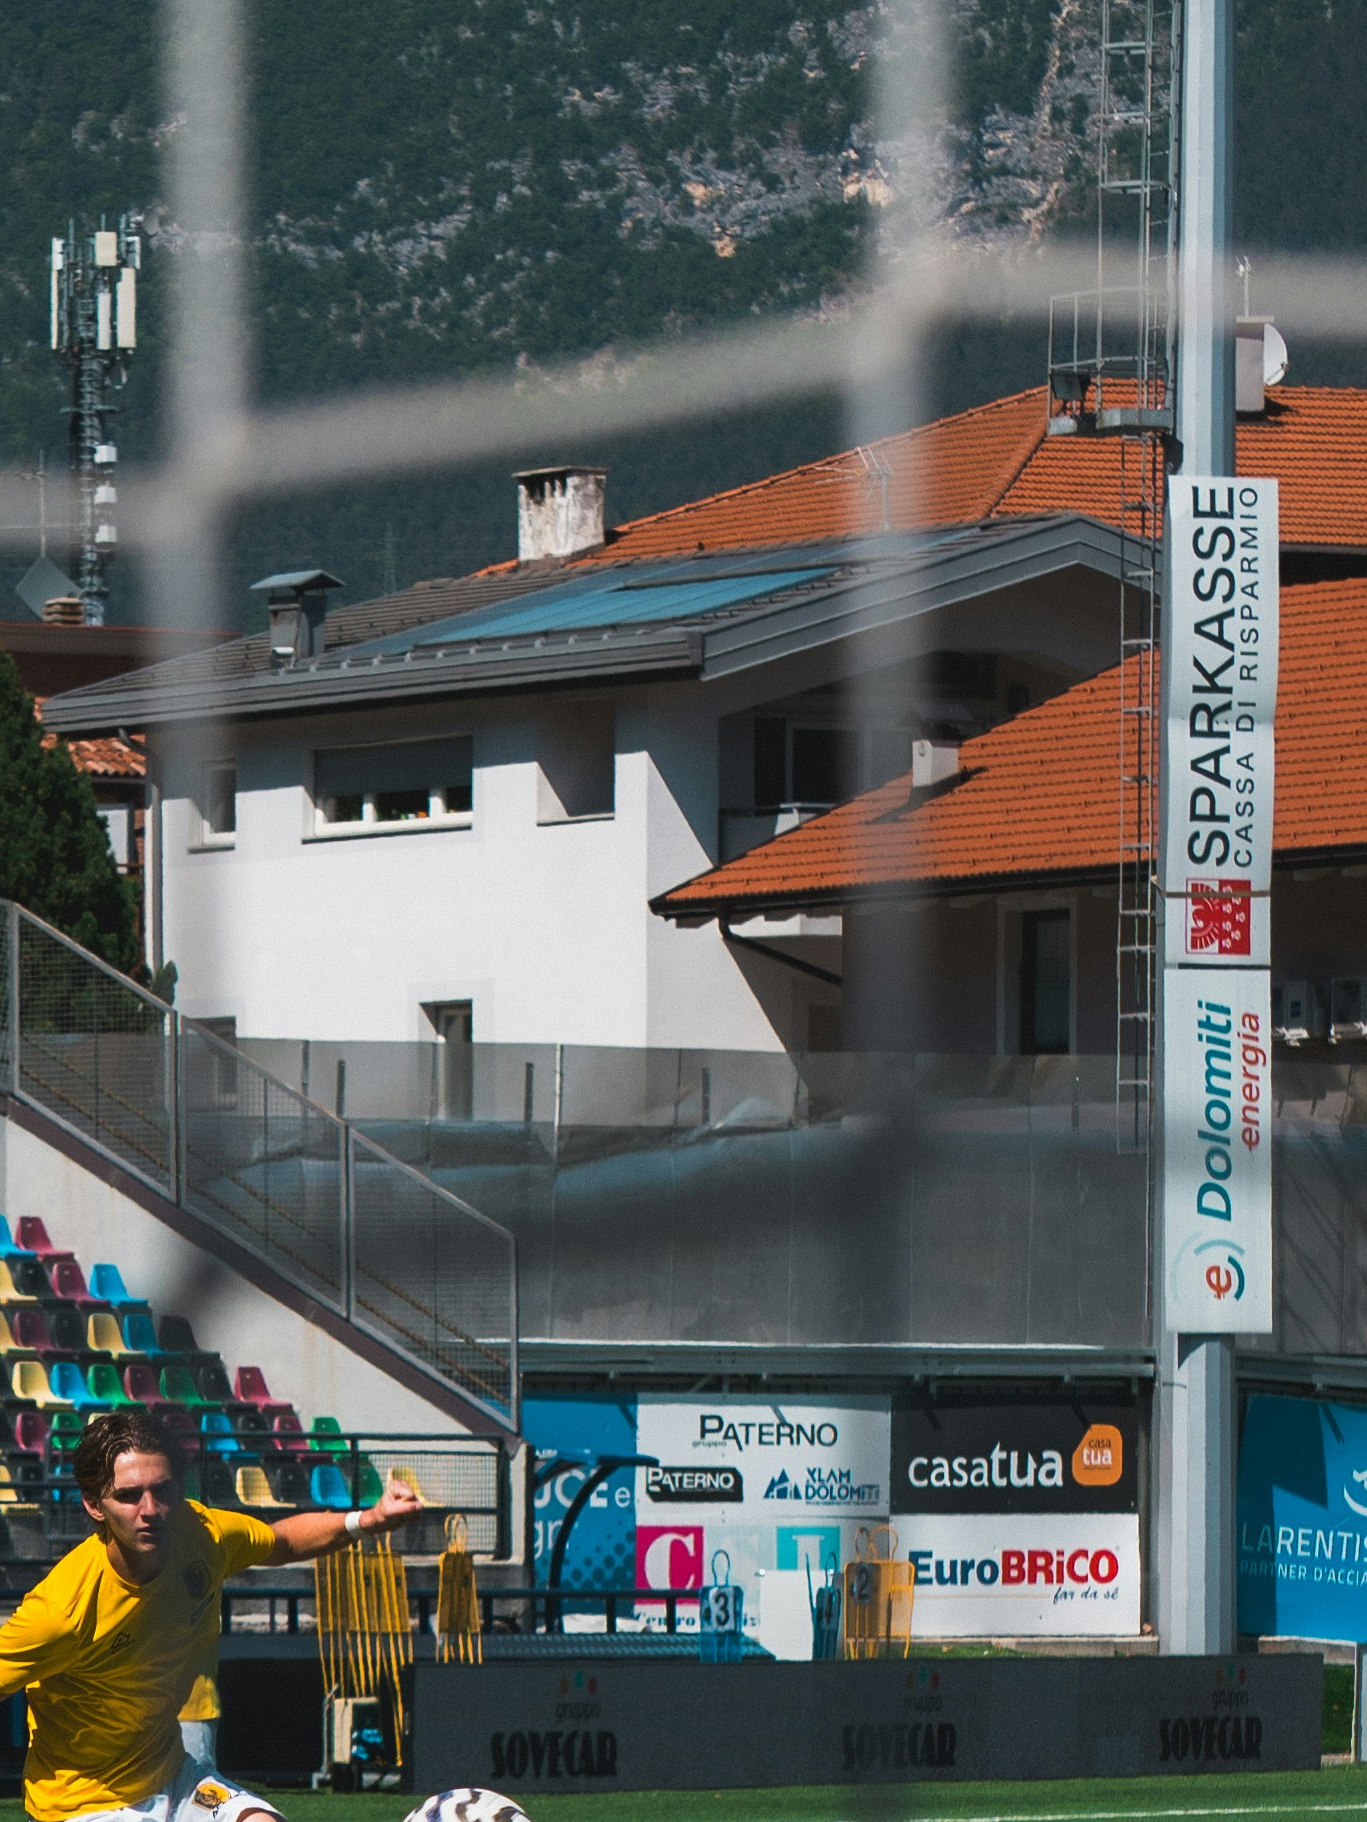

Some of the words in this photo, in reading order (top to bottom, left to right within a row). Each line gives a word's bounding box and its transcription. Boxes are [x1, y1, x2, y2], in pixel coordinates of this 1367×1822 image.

[1238, 488, 1259, 681] RISPARMIO
[1187, 486, 1235, 867] SPARKASSE
[1235, 701, 1256, 732] DI
[1234, 753, 1255, 868] CASSA
[1237, 1012, 1266, 1151] energia
[1196, 1000, 1232, 1221] Dolomiti
[700, 1414, 838, 1452] PATERNO
[1088, 1438, 1112, 1448] casa
[908, 1441, 1063, 1488] casatua
[1082, 1446, 1112, 1465] tua
[647, 1467, 735, 1492] PATERNO
[805, 1484, 880, 1500] DOLOMITI
[908, 1548, 1119, 1586] EuroBRiCO
[1239, 1559, 1307, 1581] PARTNER
[714, 1592, 731, 1627] 3
[1052, 1587, 1075, 1605] far
[1080, 1586, 1099, 1600] da
[490, 1730, 618, 1779] SOVECAR
[1159, 1716, 1263, 1762] SOVECAR
